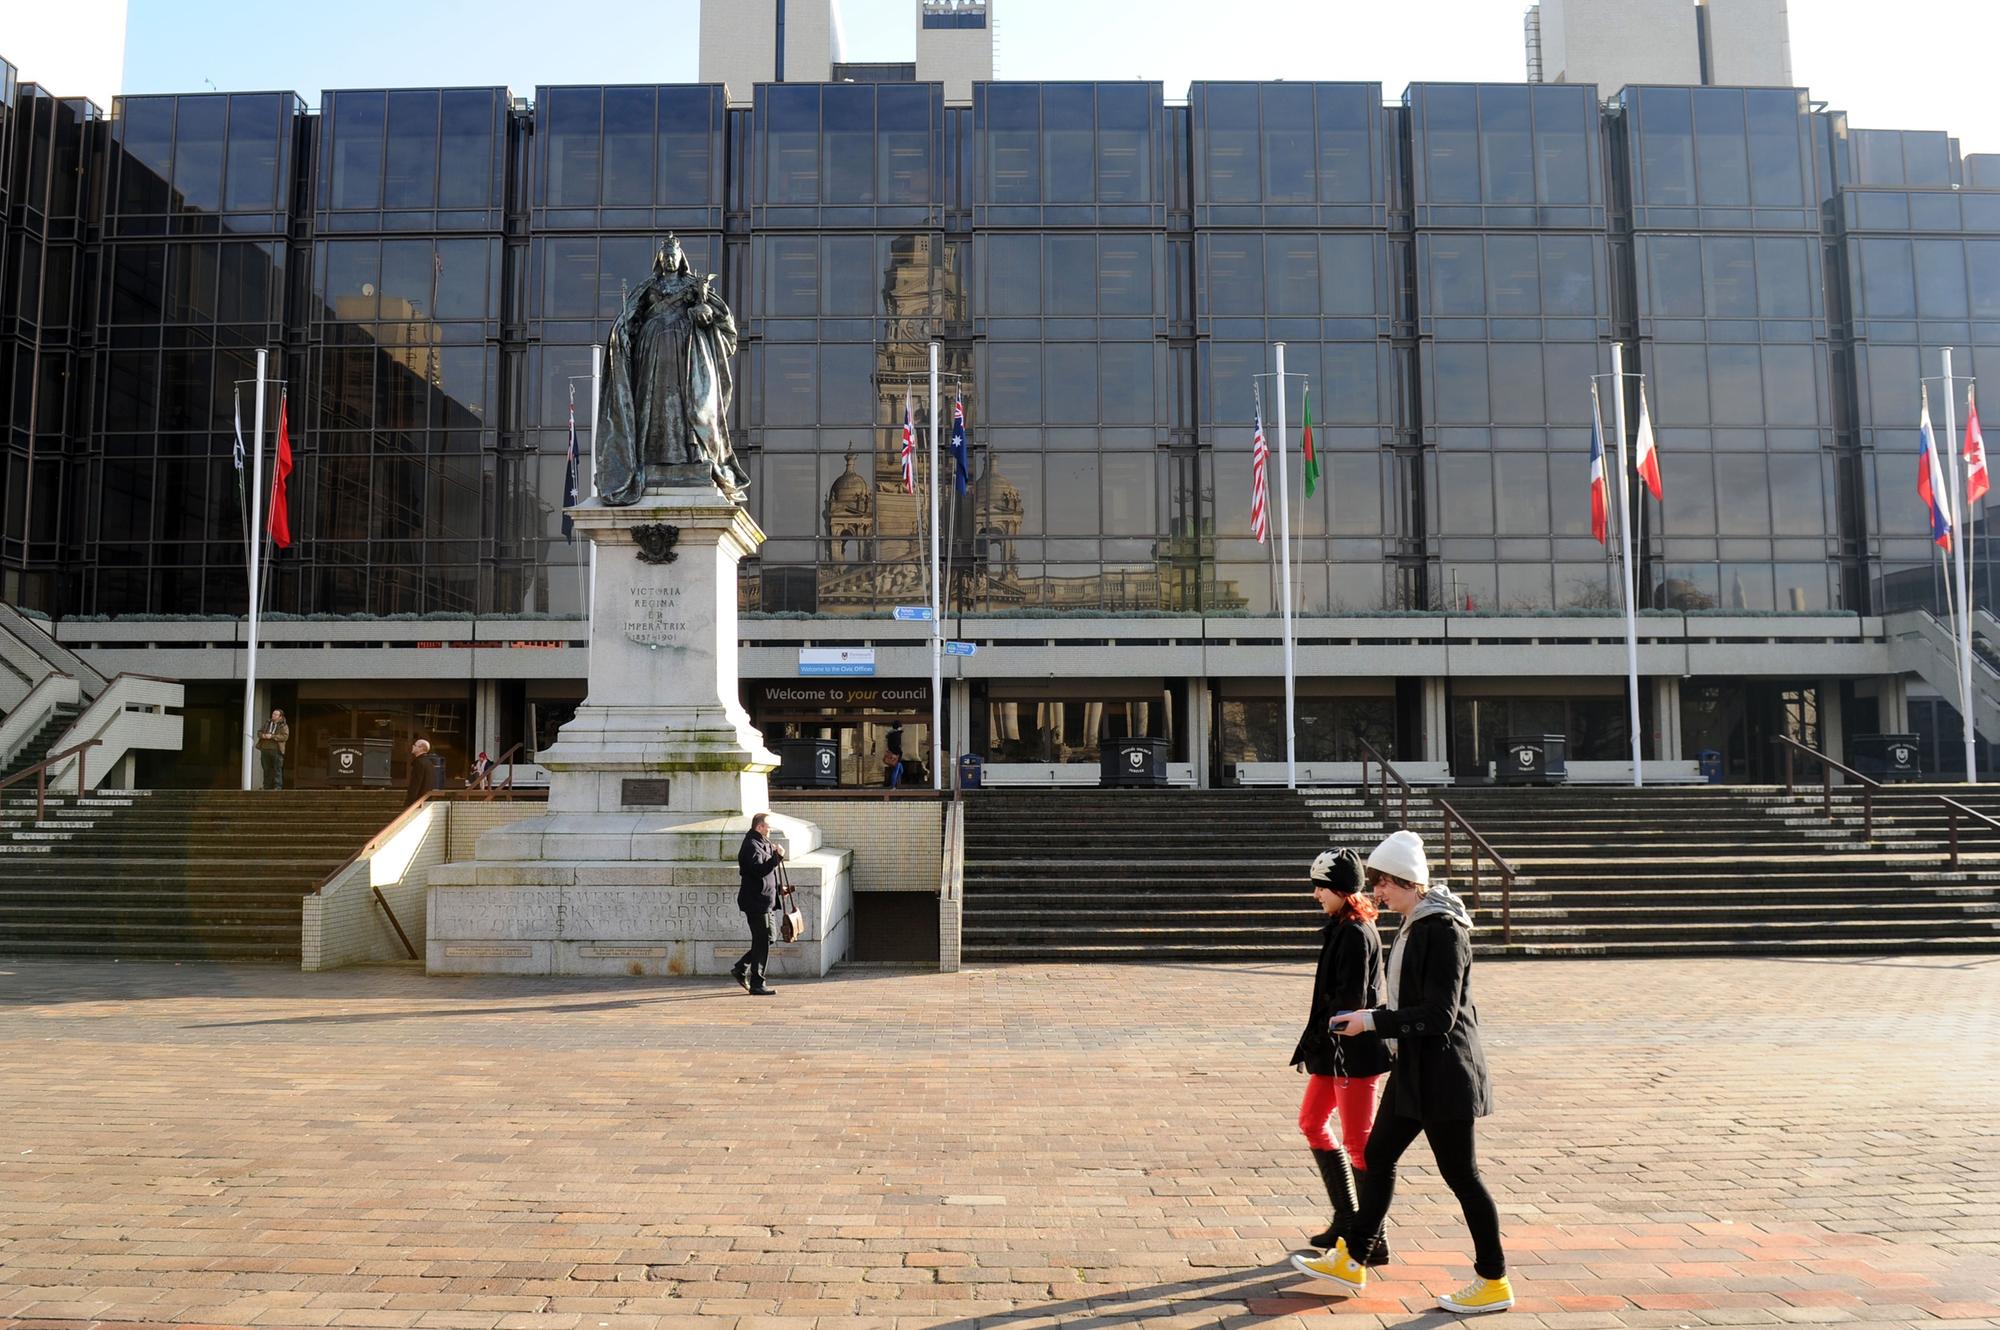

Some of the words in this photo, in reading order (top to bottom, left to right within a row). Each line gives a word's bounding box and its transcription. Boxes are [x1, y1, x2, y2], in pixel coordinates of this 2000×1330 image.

[630, 587, 680, 596] VICTORIA
[634, 599, 675, 608] REGINA
[623, 622, 686, 631] IMPERATRIX
[765, 687, 826, 700] Welcome
[830, 688, 844, 700] to
[846, 690, 879, 703] your
[881, 687, 927, 700] council
[526, 905, 583, 919] MARK
